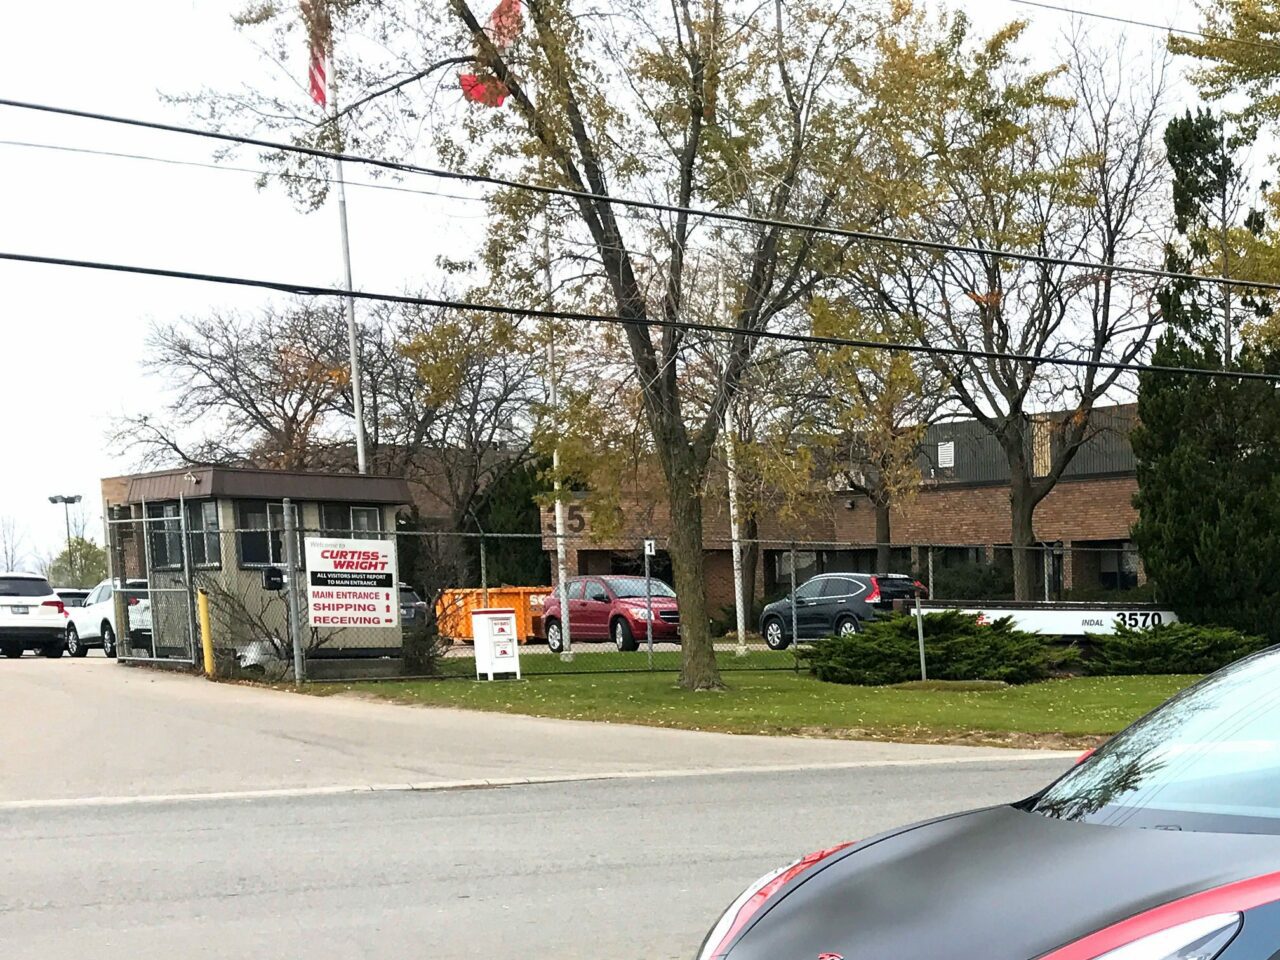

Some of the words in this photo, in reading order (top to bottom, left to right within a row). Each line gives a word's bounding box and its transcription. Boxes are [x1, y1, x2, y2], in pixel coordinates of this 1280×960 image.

[648, 543, 653, 553] 1
[333, 560, 388, 570] WRIGHT
[312, 591, 333, 599] MAIN
[336, 592, 380, 600] ENTRANCE
[313, 603, 376, 612] SHIPPING
[313, 616, 381, 625] RECEIVING
[1116, 612, 1162, 628] 3570
